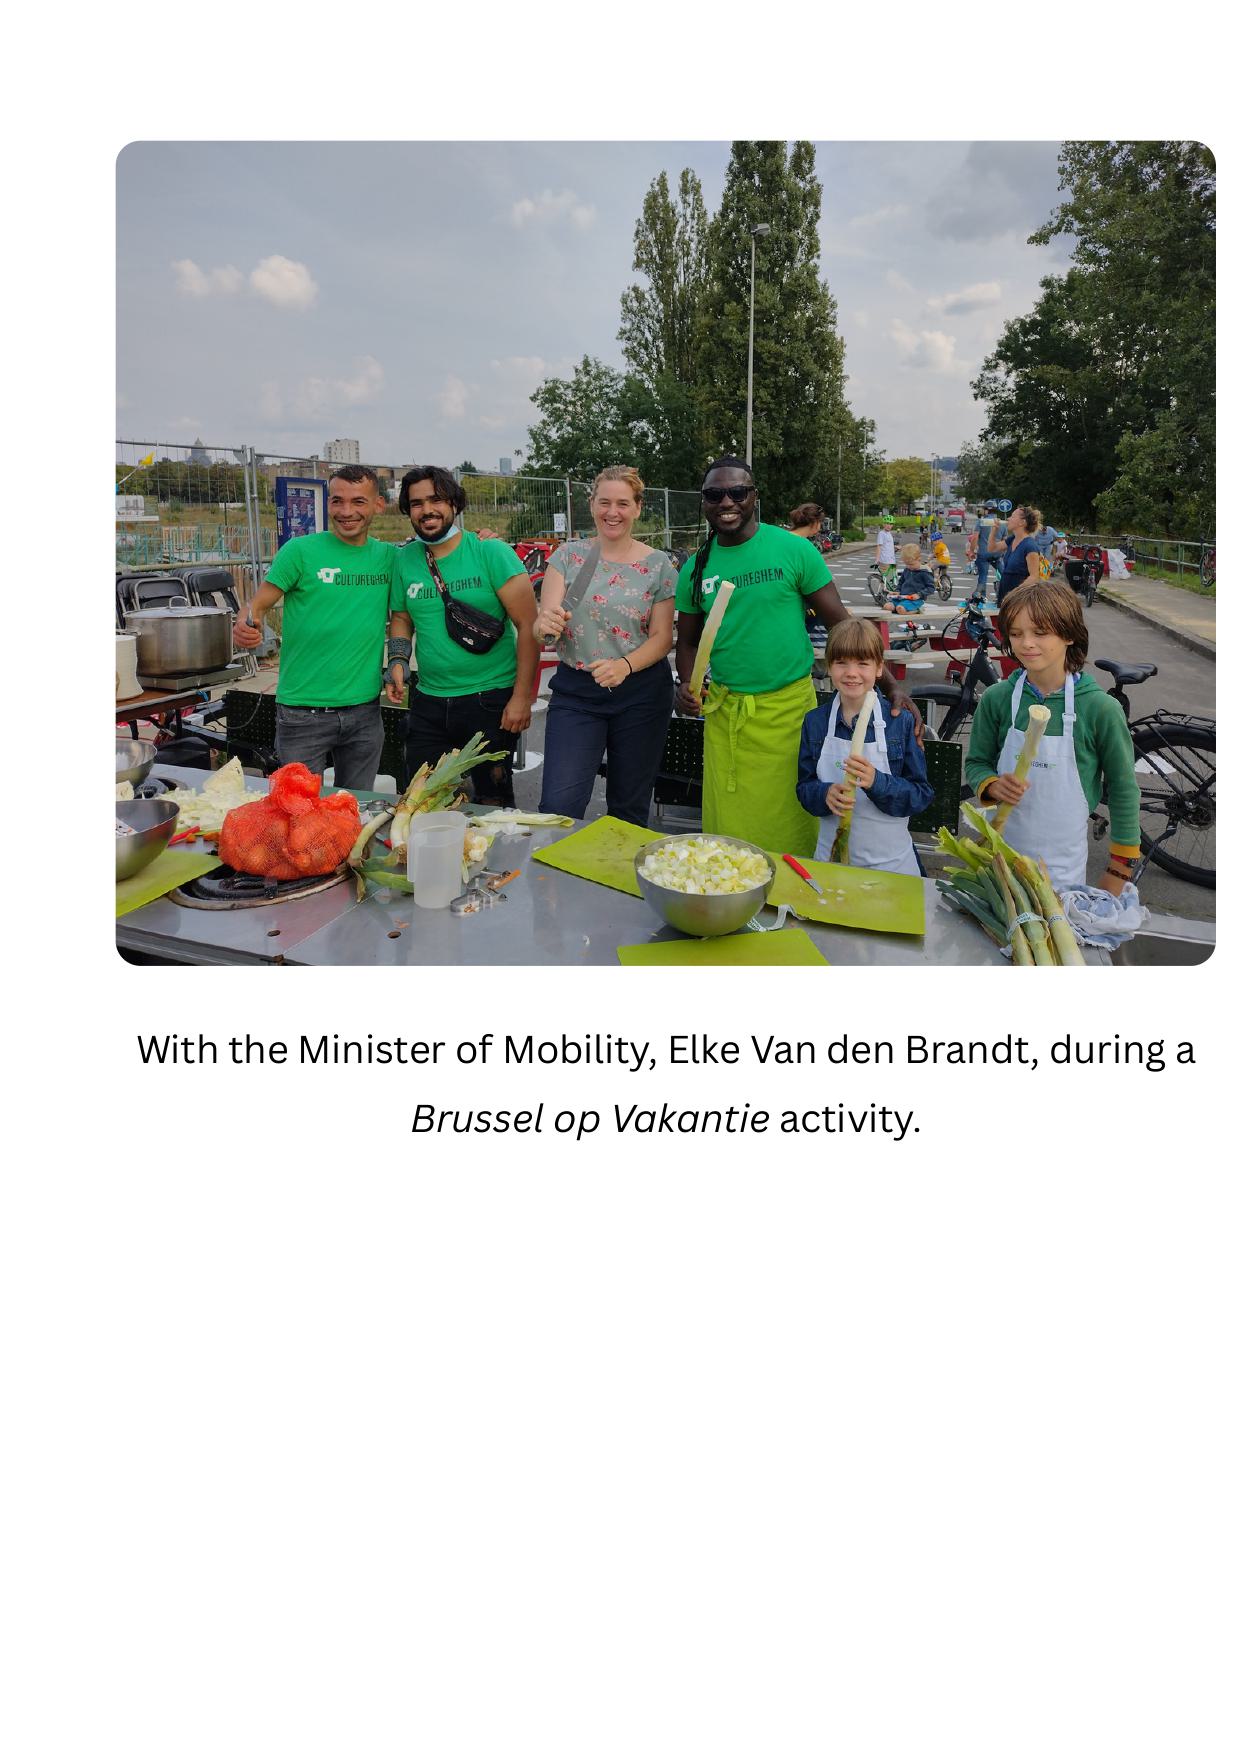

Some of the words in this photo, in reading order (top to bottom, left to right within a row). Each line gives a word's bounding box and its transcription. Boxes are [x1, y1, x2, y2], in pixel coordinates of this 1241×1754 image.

[335, 572, 390, 586] CULTUREGHEM
[417, 575, 482, 600] CULTREGHEM
[714, 567, 784, 594] CTUREGHEM
